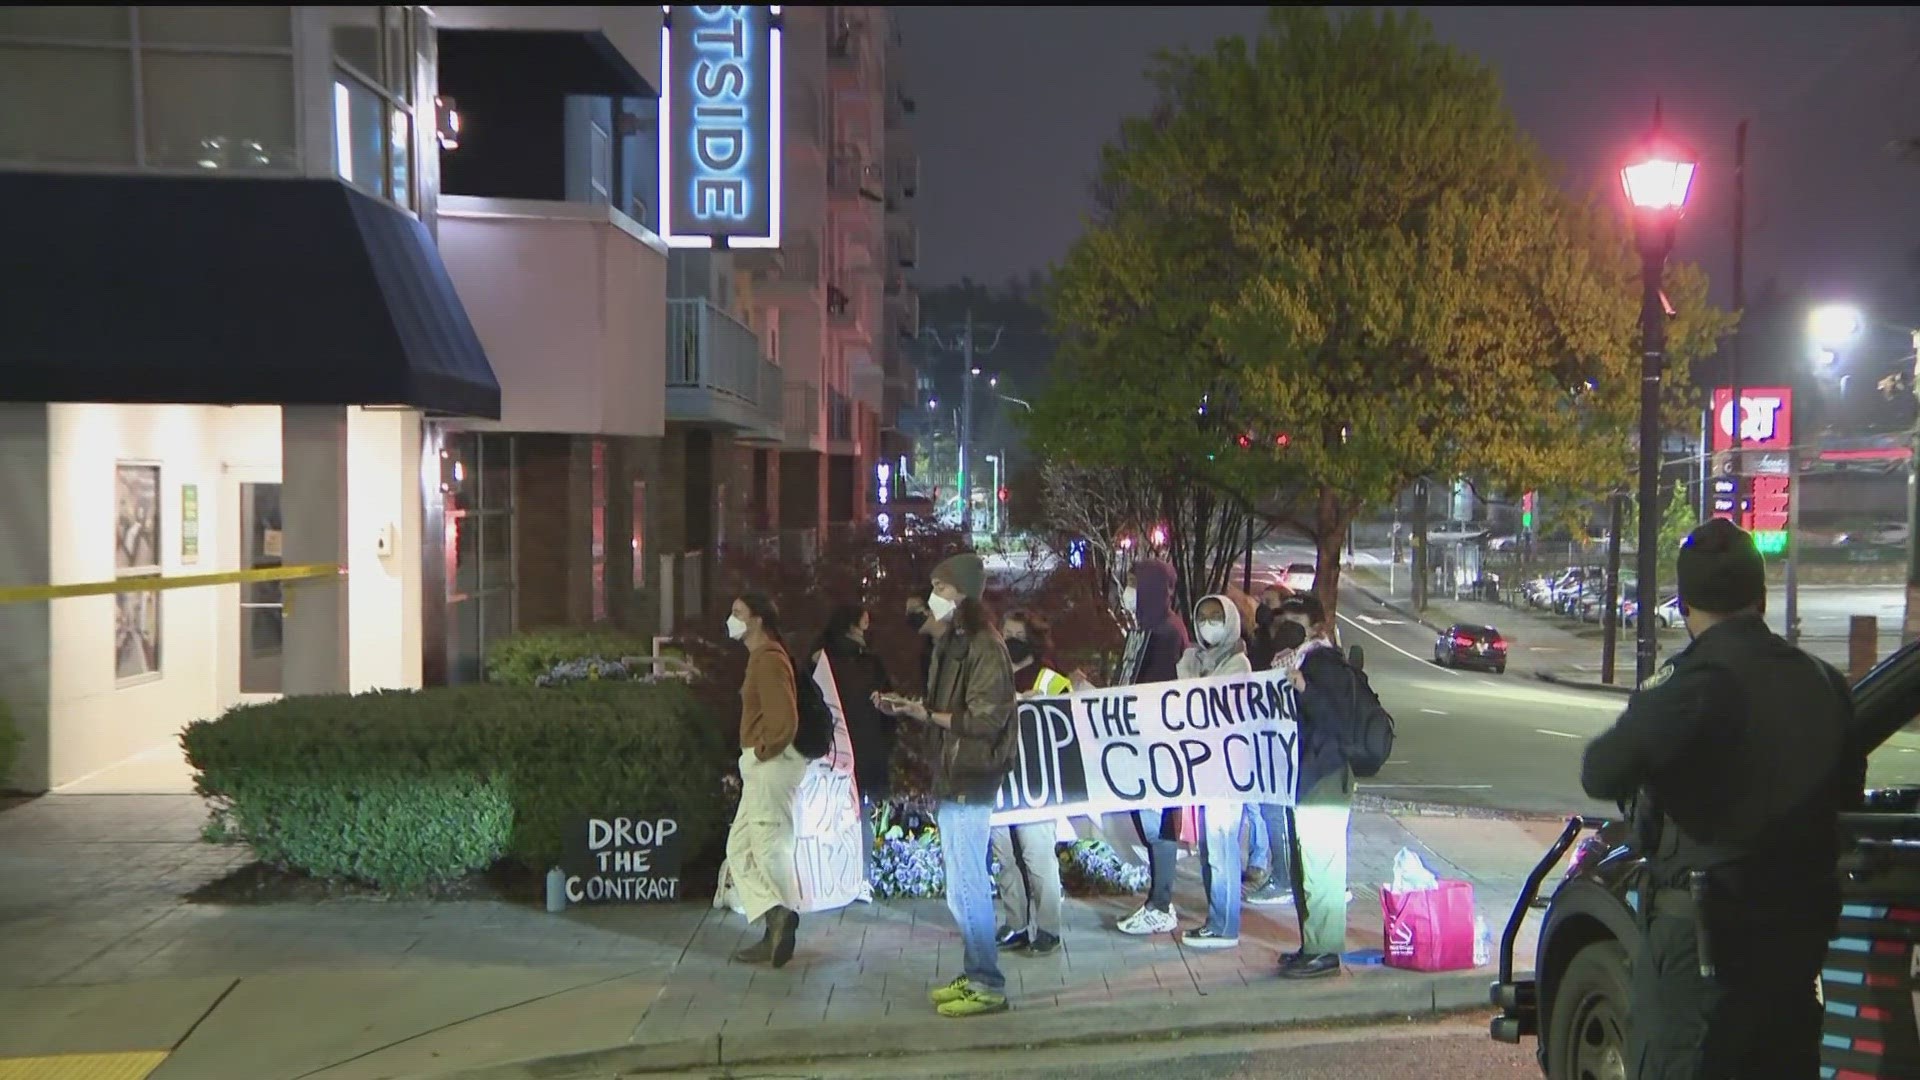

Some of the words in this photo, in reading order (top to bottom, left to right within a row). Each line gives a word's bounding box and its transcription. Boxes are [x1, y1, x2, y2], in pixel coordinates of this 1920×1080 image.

[1720, 396, 1781, 442] QT
[1081, 695, 1140, 740] THE
[1101, 740, 1212, 801] COP
[1223, 731, 1296, 795] CITY
[588, 817, 677, 850] DROP
[596, 849, 651, 873] THE
[565, 875, 679, 902] CONTRACT
